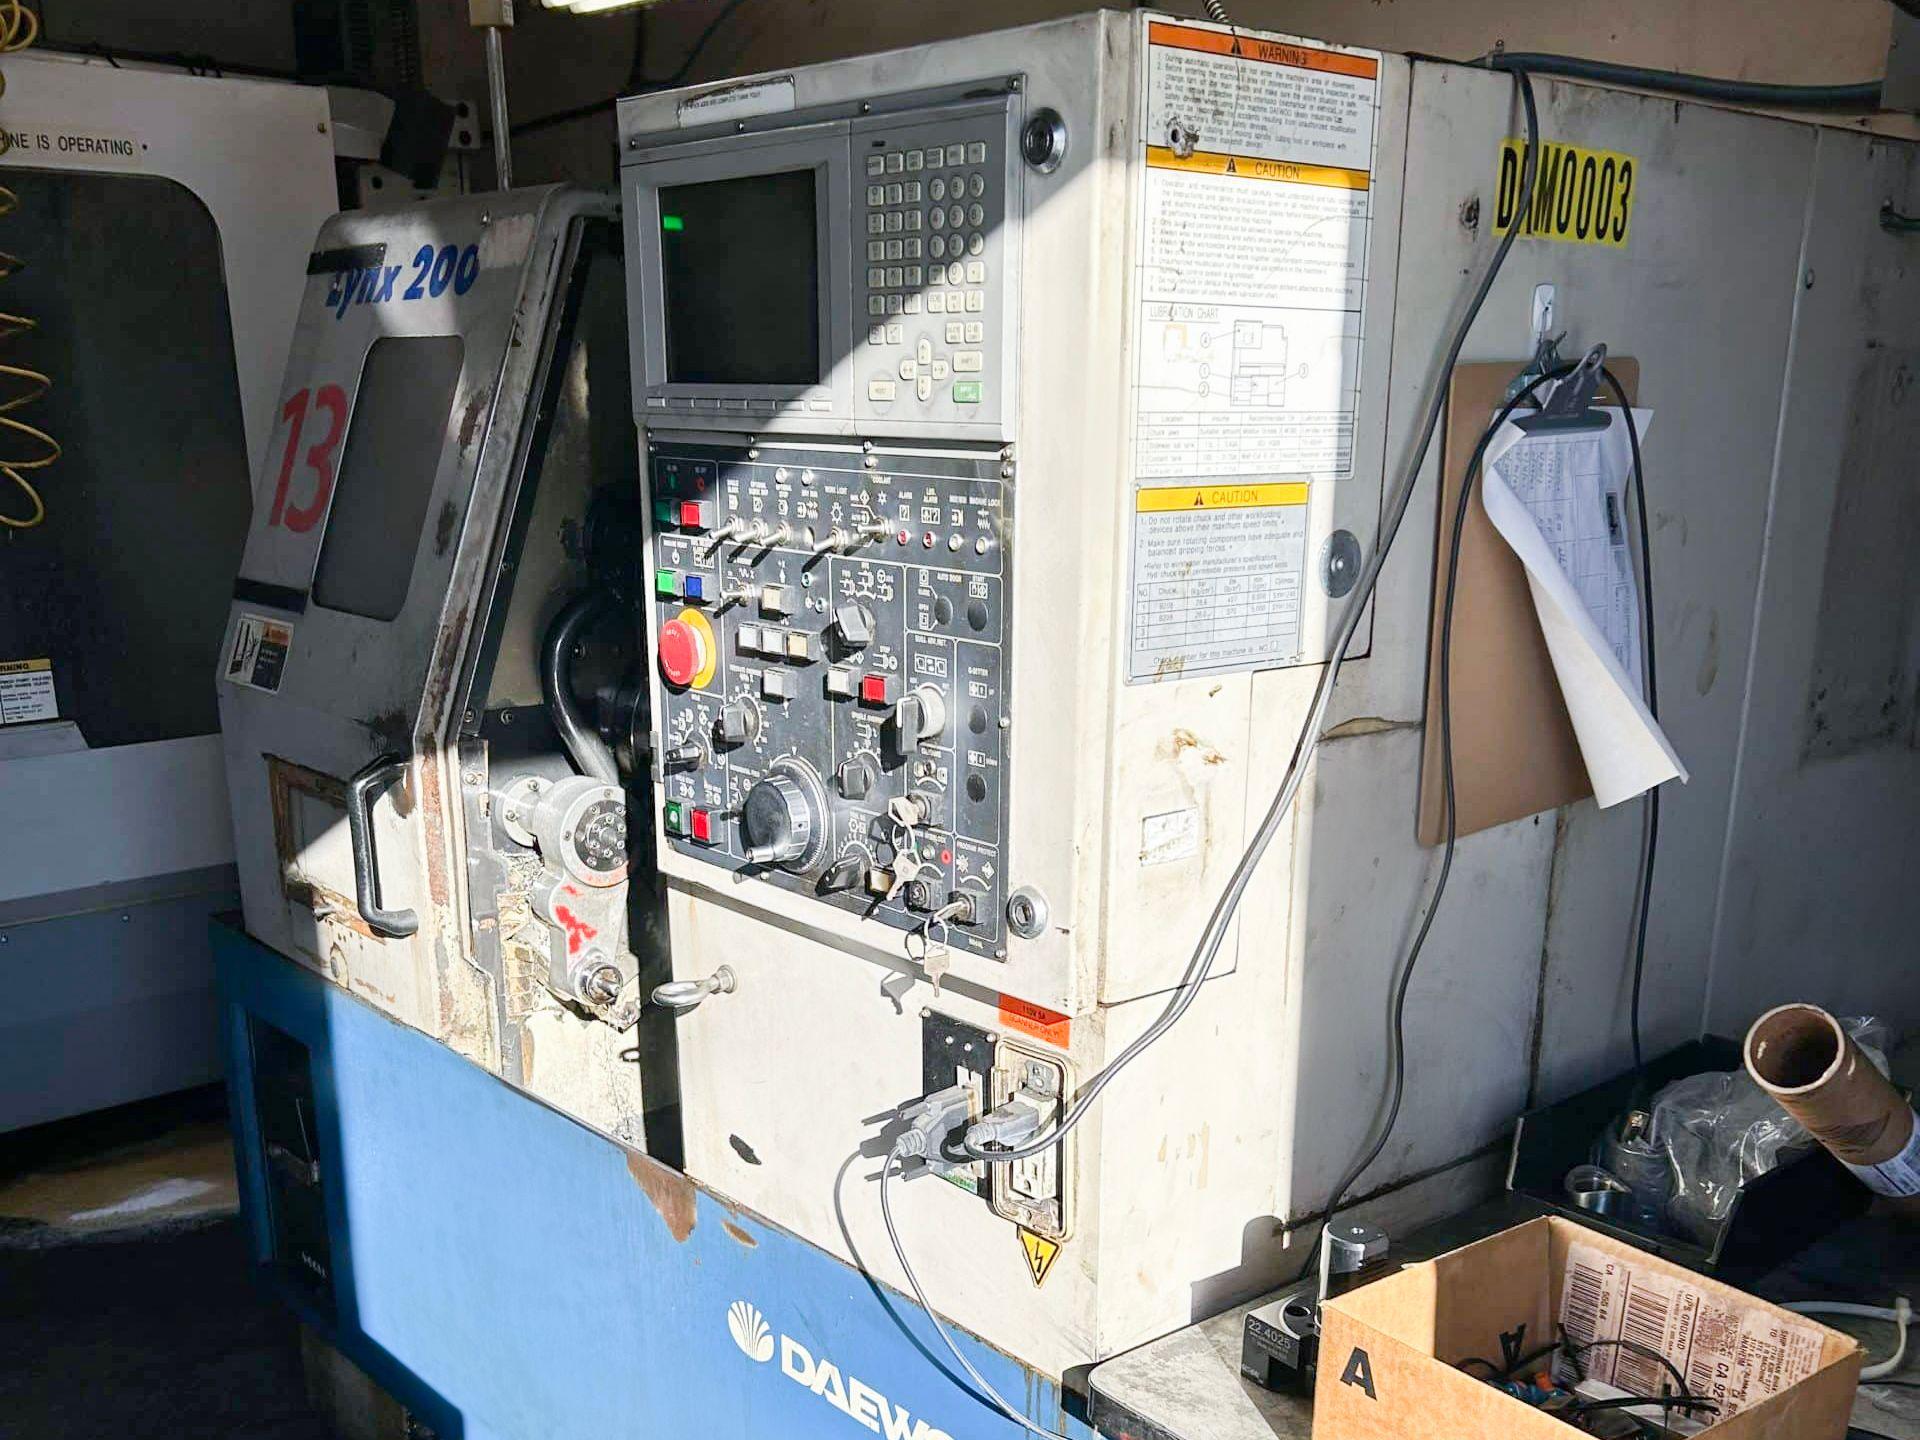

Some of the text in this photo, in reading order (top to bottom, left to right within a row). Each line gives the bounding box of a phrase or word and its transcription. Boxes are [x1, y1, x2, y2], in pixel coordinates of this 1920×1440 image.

[37, 134, 50, 150] IS
[58, 135, 134, 156] OPERATING
[1255, 162, 1301, 180] CAUTION
[326, 243, 480, 320] Lynx 200
[269, 384, 348, 533] 13
[1211, 490, 1258, 505] CAUTION
[1148, 516, 1157, 524] Do
[1159, 516, 1170, 524] not
[1172, 515, 1191, 523] rotate
[1214, 513, 1225, 521] and
[1174, 524, 1193, 532] above
[1147, 538, 1164, 547] Make
[1147, 547, 1176, 557] balanced
[1606, 1264, 1614, 1276] CA
[1676, 1293, 1693, 1350] UPS GROUND
[1770, 1328, 1778, 1338] TO
[1779, 1329, 1788, 1347] SHIP
[1737, 1334, 1750, 1367] ANAHEIM
[1340, 1345, 1378, 1401] A
[1716, 1362, 1729, 1380] CA
[1758, 1357, 1767, 1382] MACHINE
[780, 1334, 955, 1440] DAEW
